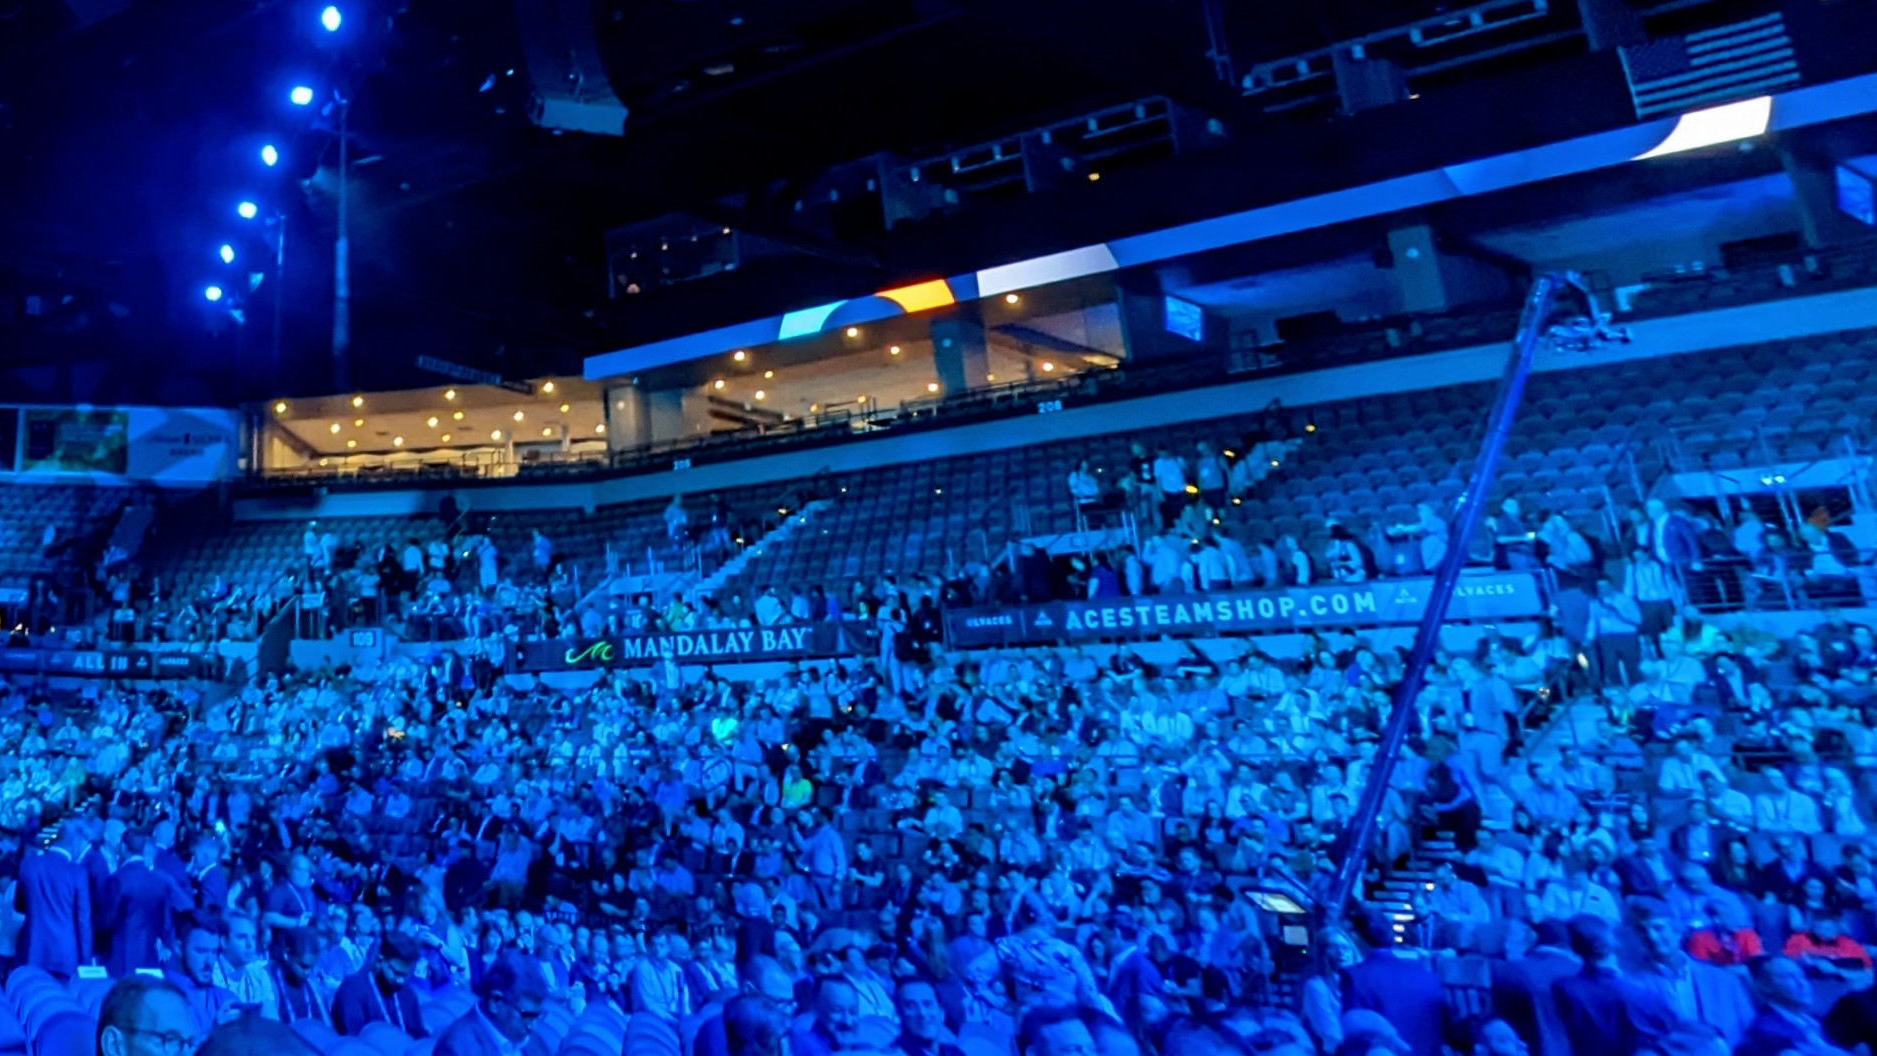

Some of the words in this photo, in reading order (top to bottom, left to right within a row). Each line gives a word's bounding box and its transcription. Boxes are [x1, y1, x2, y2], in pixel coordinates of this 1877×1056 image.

[1065, 588, 1377, 631] ACESTEAMSHOP.COM
[624, 631, 755, 659] MANDALAY
[761, 627, 806, 652] BAY
[73, 655, 105, 670] ALL
